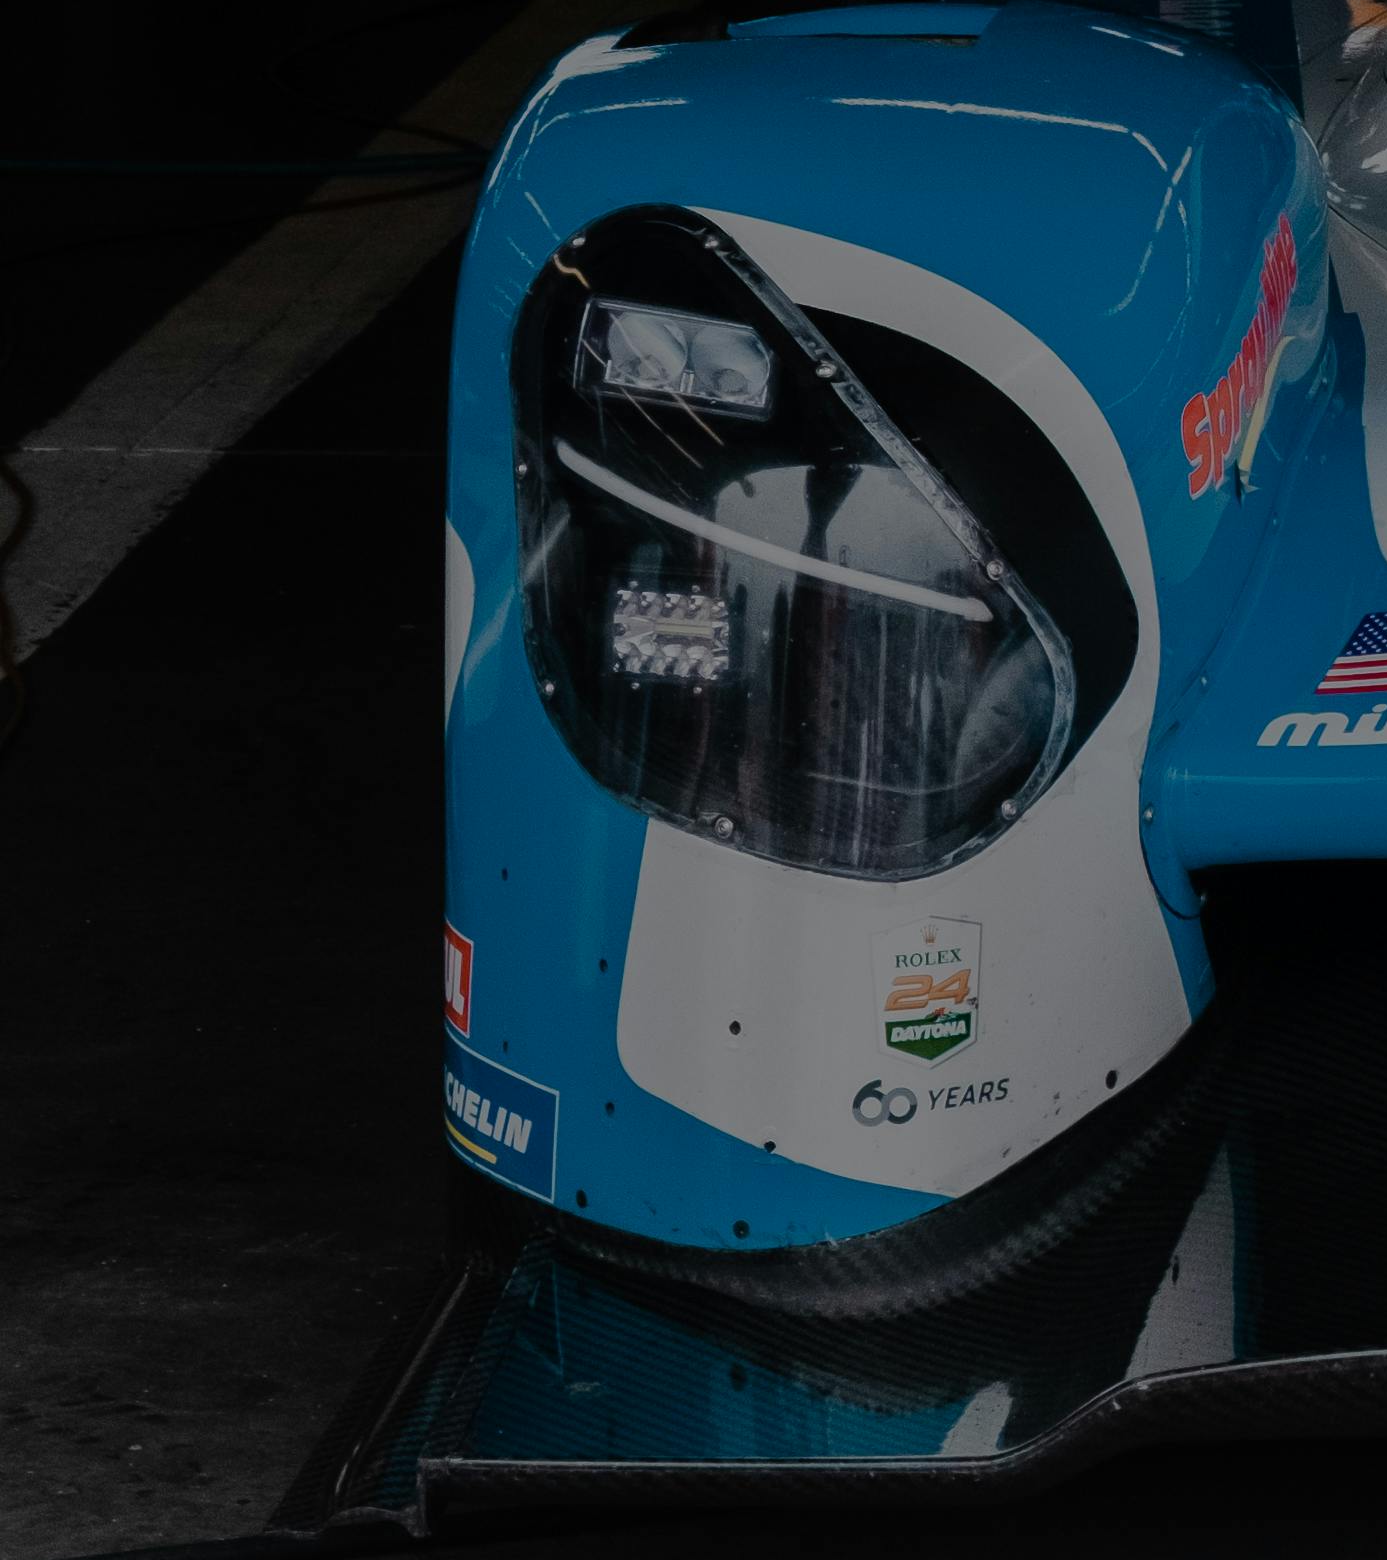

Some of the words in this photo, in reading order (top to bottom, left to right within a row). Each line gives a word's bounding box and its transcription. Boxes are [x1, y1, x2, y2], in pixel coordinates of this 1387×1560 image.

[895, 947, 962, 968] ROLEX
[884, 968, 972, 1011] 24
[890, 1019, 968, 1043] DAYTONA
[852, 1080, 919, 1127] 60
[928, 1078, 1011, 1111] YEARS
